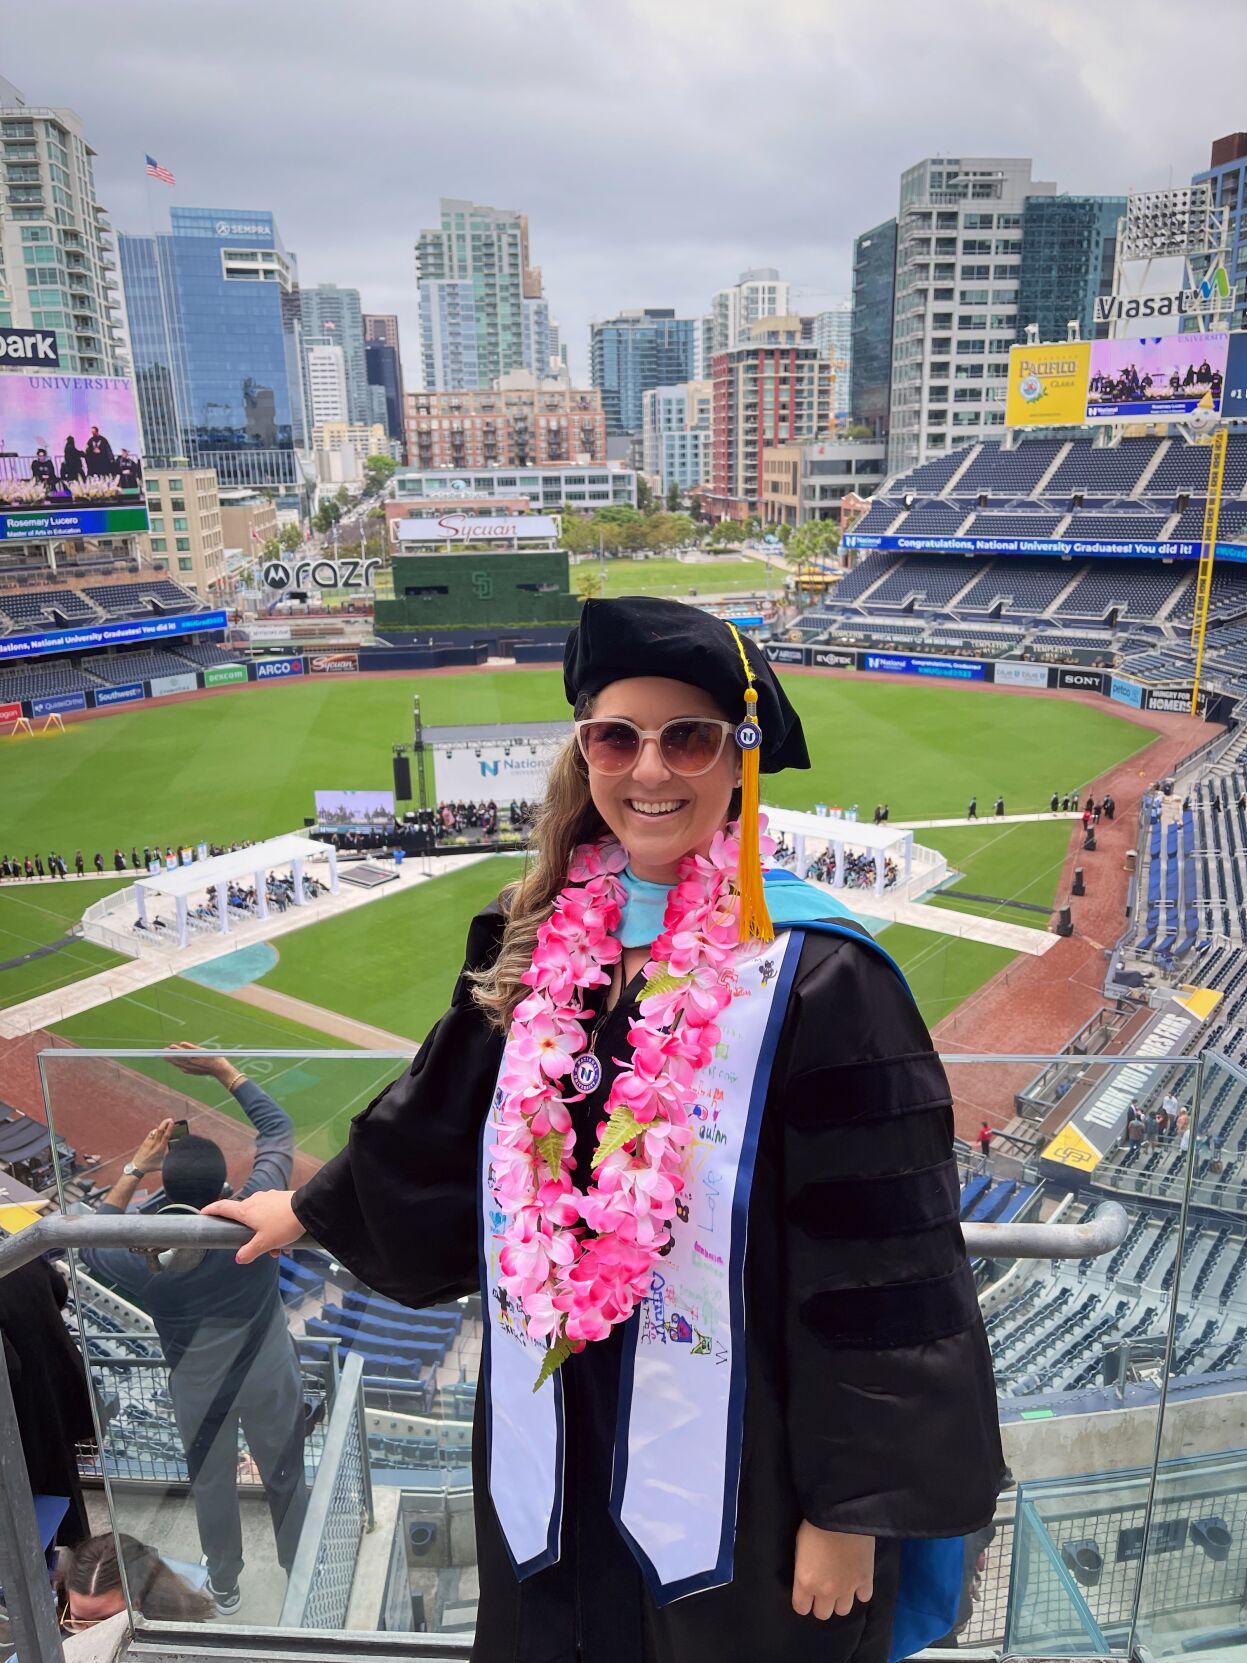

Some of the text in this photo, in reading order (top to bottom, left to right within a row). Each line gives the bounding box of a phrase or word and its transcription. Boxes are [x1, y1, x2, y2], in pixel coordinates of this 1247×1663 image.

[232, 223, 271, 235] SEMPRA
[1100, 292, 1187, 319] Viasat
[29, 376, 130, 391] UNIVERSITY
[7, 516, 79, 528] Rosemary Lucero
[437, 513, 518, 544] Sycuan
[898, 538, 1193, 554] Congratulations, National University Graduates! You did it!
[295, 559, 382, 588] razr
[31, 637, 65, 649] National
[65, 632, 102, 645] University
[103, 627, 141, 640] Graduates!
[141, 625, 156, 634] You
[156, 622, 168, 632] did
[258, 662, 290, 676] ARCO
[311, 656, 353, 672] Sycuan
[1064, 675, 1100, 686] SONY
[98, 688, 137, 700] Southwest
[1178, 691, 1191, 700] FOR
[1083, 1086, 1135, 1129] THANK
[1111, 1066, 1149, 1094] YOU
[1153, 1013, 1192, 1041] FANS
